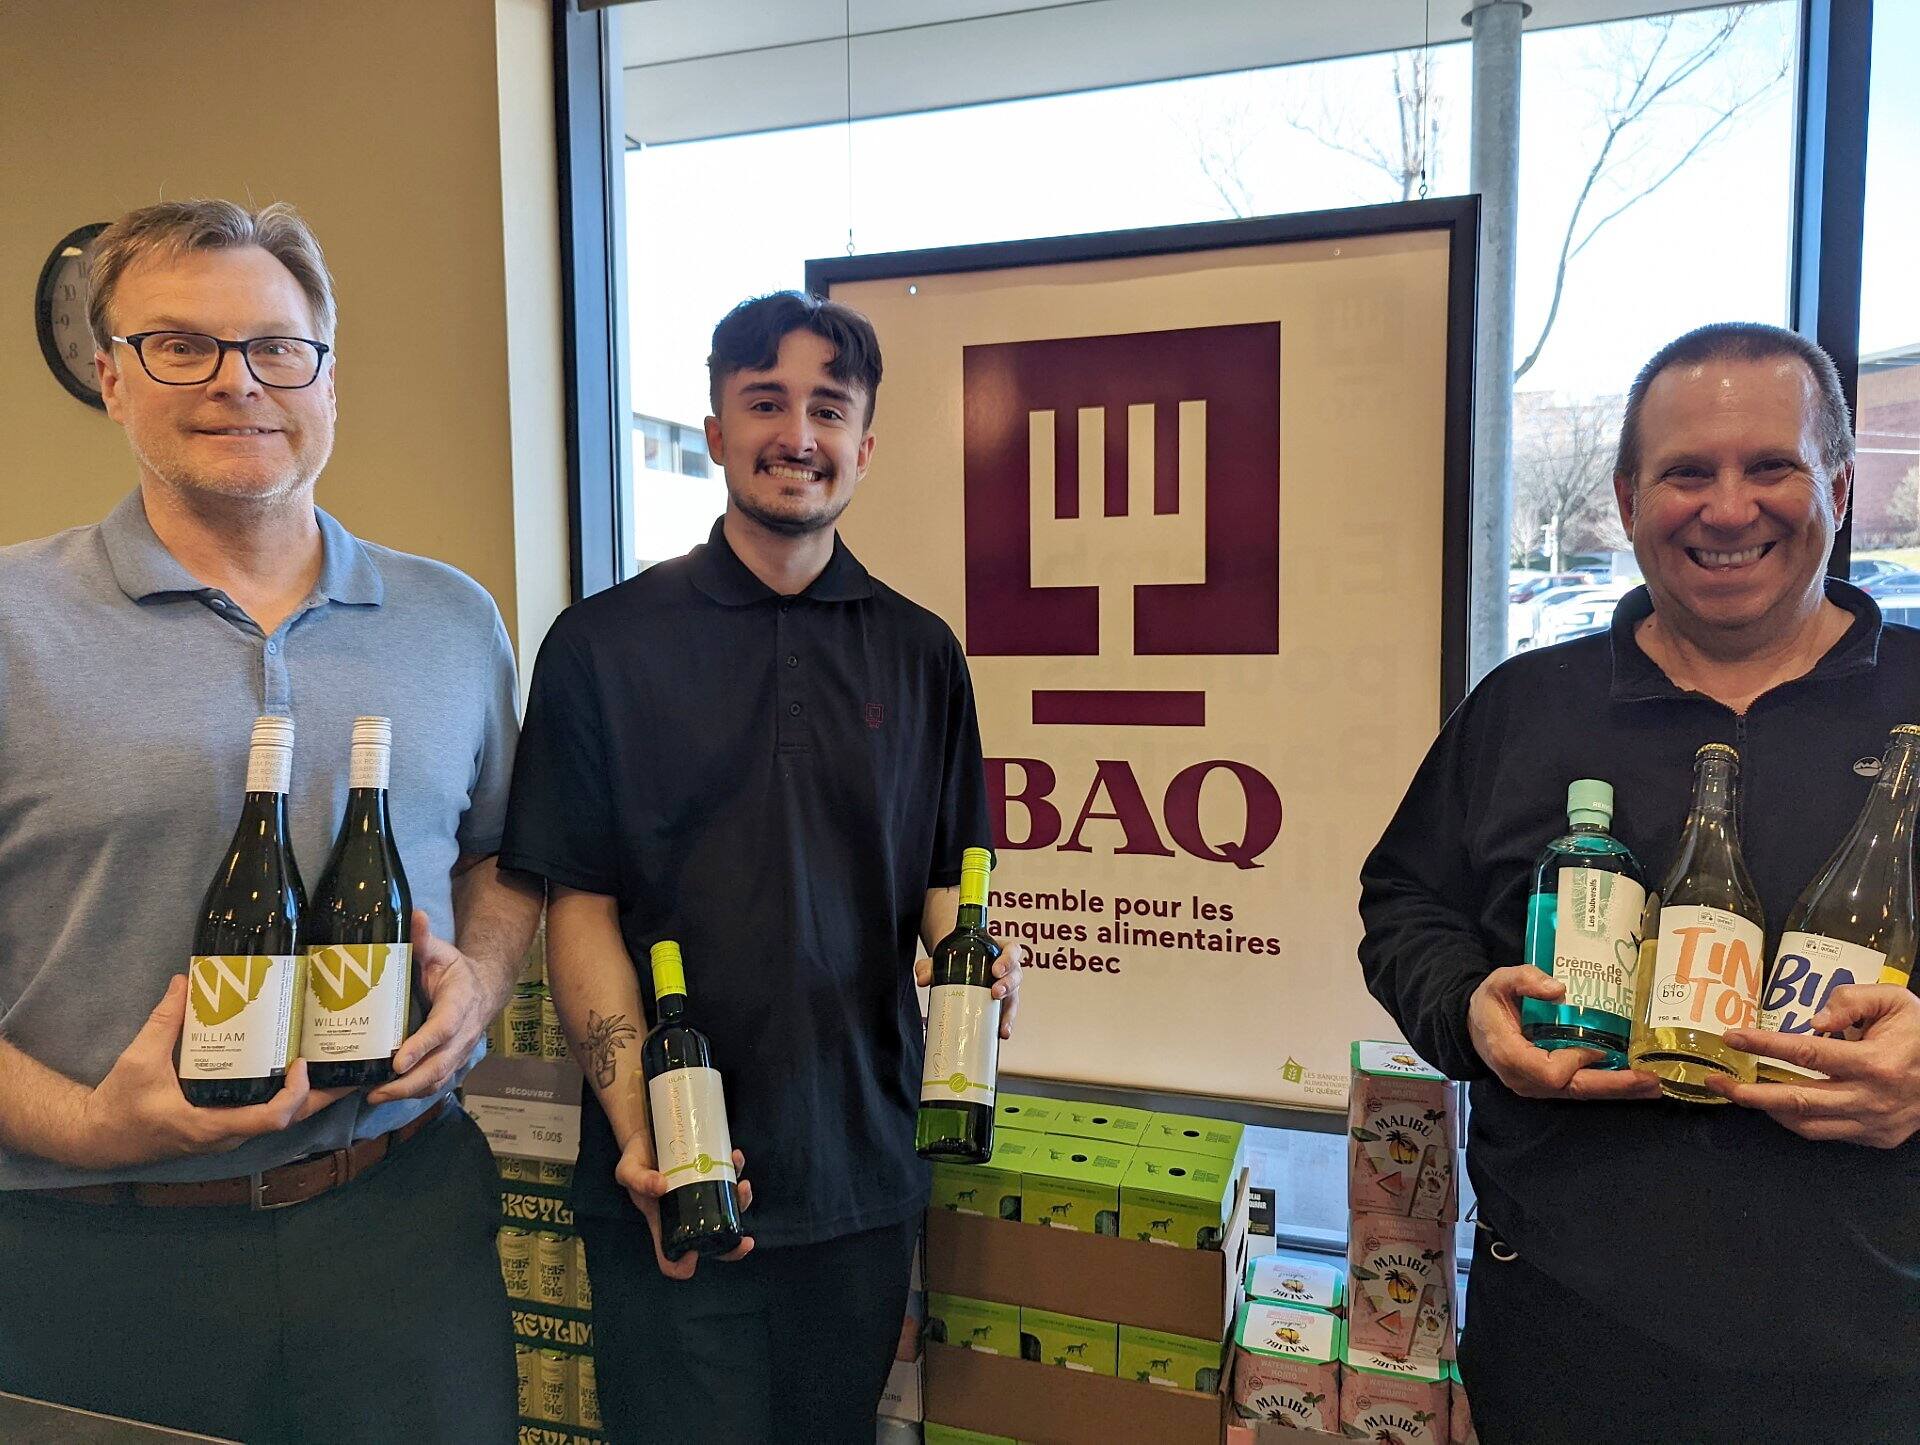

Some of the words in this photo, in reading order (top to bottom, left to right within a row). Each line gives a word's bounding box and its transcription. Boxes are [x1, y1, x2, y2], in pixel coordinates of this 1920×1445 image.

[63, 284, 76, 301] 10
[60, 314, 70, 330] 9
[68, 342, 79, 359] 8
[983, 758, 1283, 870] BAQ
[987, 888, 1104, 913] nsemble
[1114, 898, 1181, 920] pour
[1192, 896, 1234, 922] les
[1587, 878, 1597, 917] Subversifs
[988, 920, 1088, 945] anques
[1097, 921, 1281, 956] alimentaires
[1019, 944, 1121, 974] Québec
[1555, 957, 1602, 972] Crème
[1607, 964, 1622, 977] de
[1569, 967, 1622, 985] menthe
[1662, 989, 1685, 998] bio
[314, 1016, 370, 1027] WILLIAM
[191, 1032, 245, 1042] WILLIAM
[505, 1087, 554, 1099] DÉCOUVREZ
[1375, 1114, 1433, 1137] MALIBU
[1373, 1254, 1431, 1277] MALIBU
[1263, 1338, 1310, 1353] MALIBU
[1369, 1356, 1418, 1371] MALIBU
[1256, 1394, 1313, 1419] MALIBU
[1364, 1414, 1423, 1438] MALIBU
